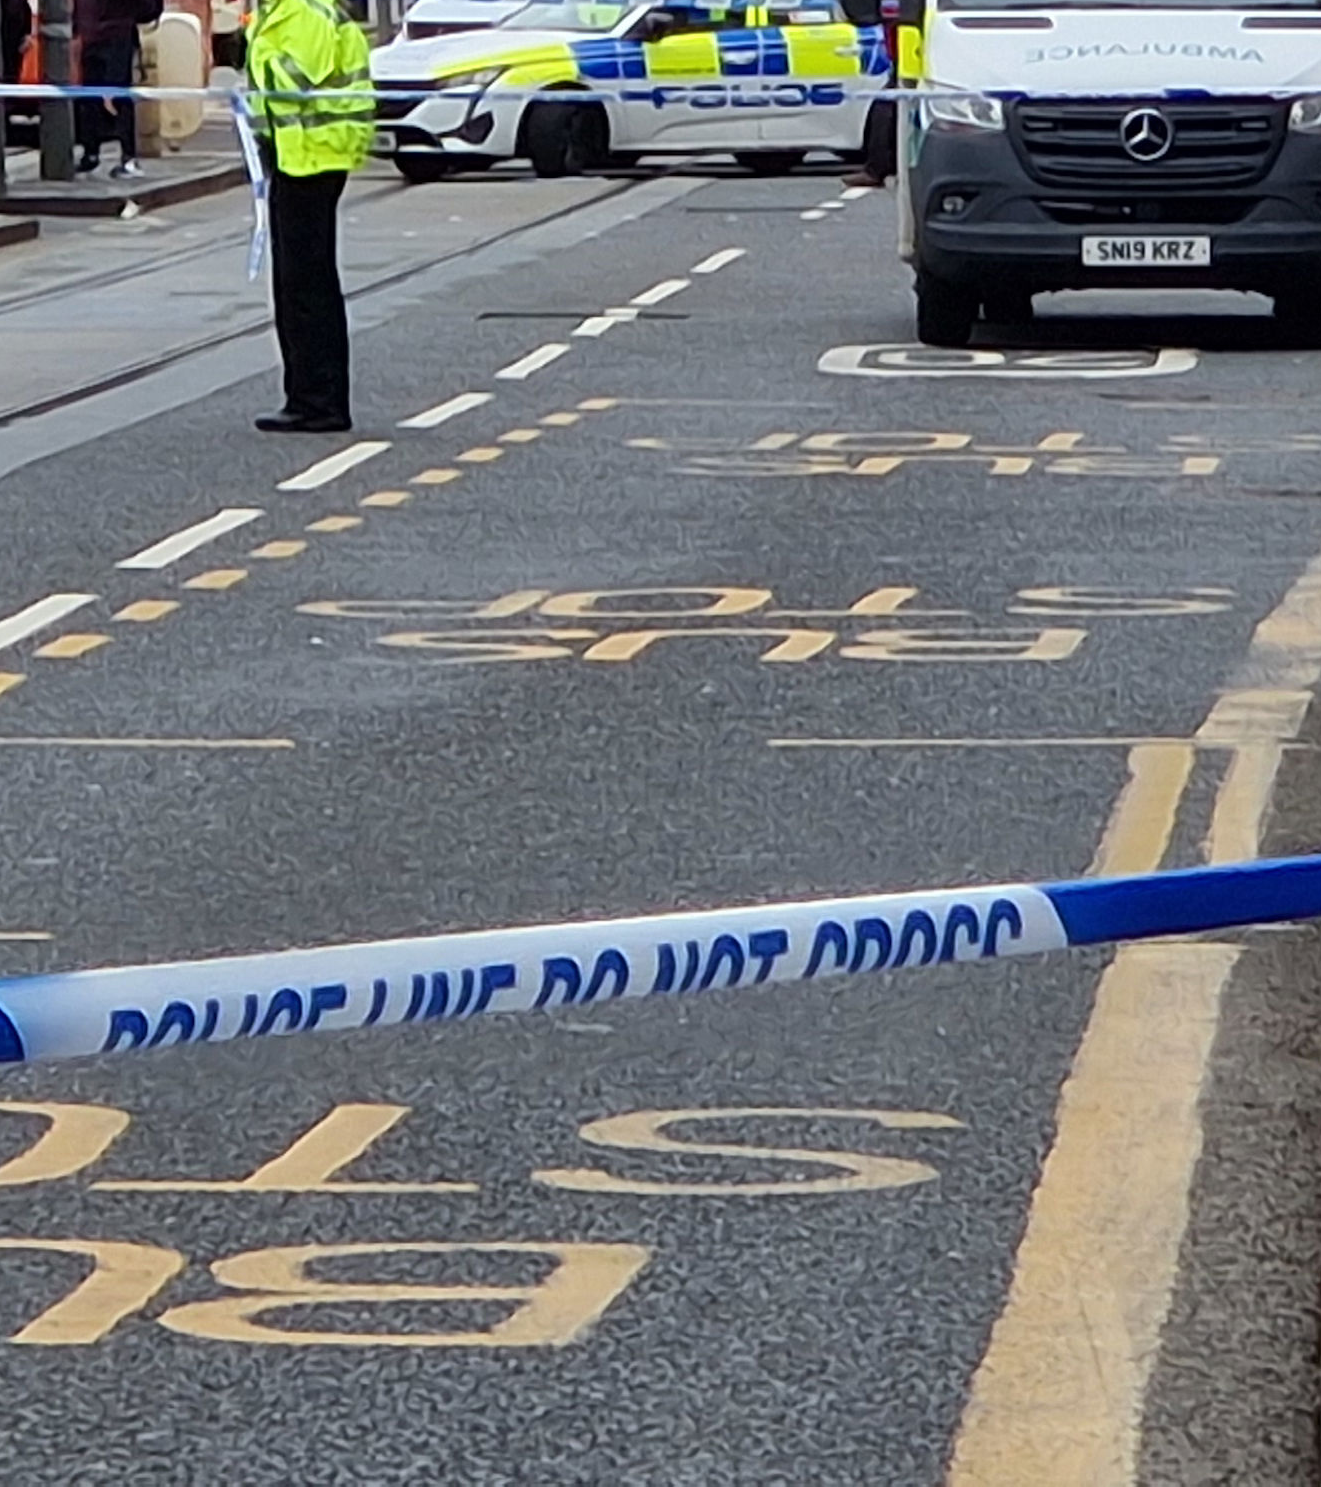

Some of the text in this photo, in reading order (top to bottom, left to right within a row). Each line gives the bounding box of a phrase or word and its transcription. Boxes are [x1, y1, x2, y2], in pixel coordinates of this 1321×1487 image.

[1097, 240, 1196, 261] SN19 KRZ
[293, 587, 1240, 619] STOP
[374, 628, 1090, 664] BUS
